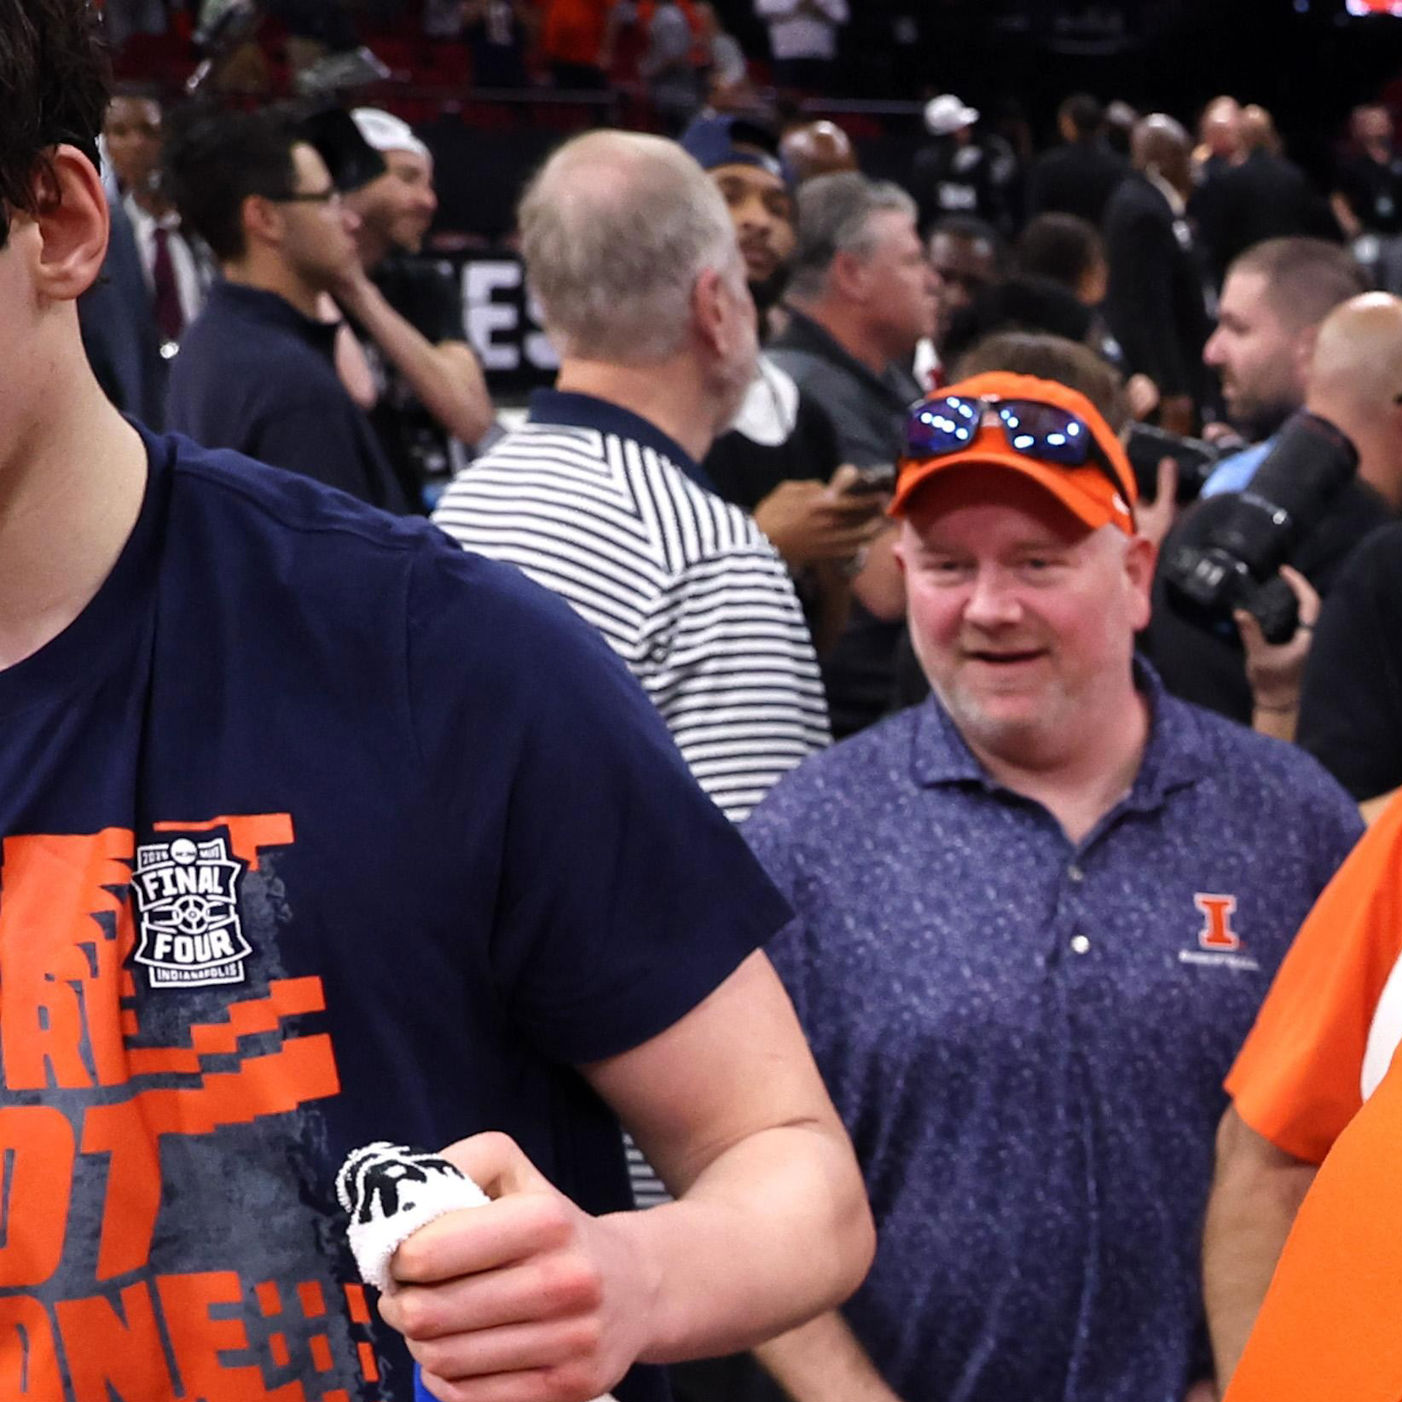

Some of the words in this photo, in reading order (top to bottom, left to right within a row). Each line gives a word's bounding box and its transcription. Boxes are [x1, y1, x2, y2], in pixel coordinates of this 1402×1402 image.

[141, 865, 224, 901] FINAL
[153, 928, 236, 964] FOUR
[156, 963, 237, 982] INDIANAPOLIS
